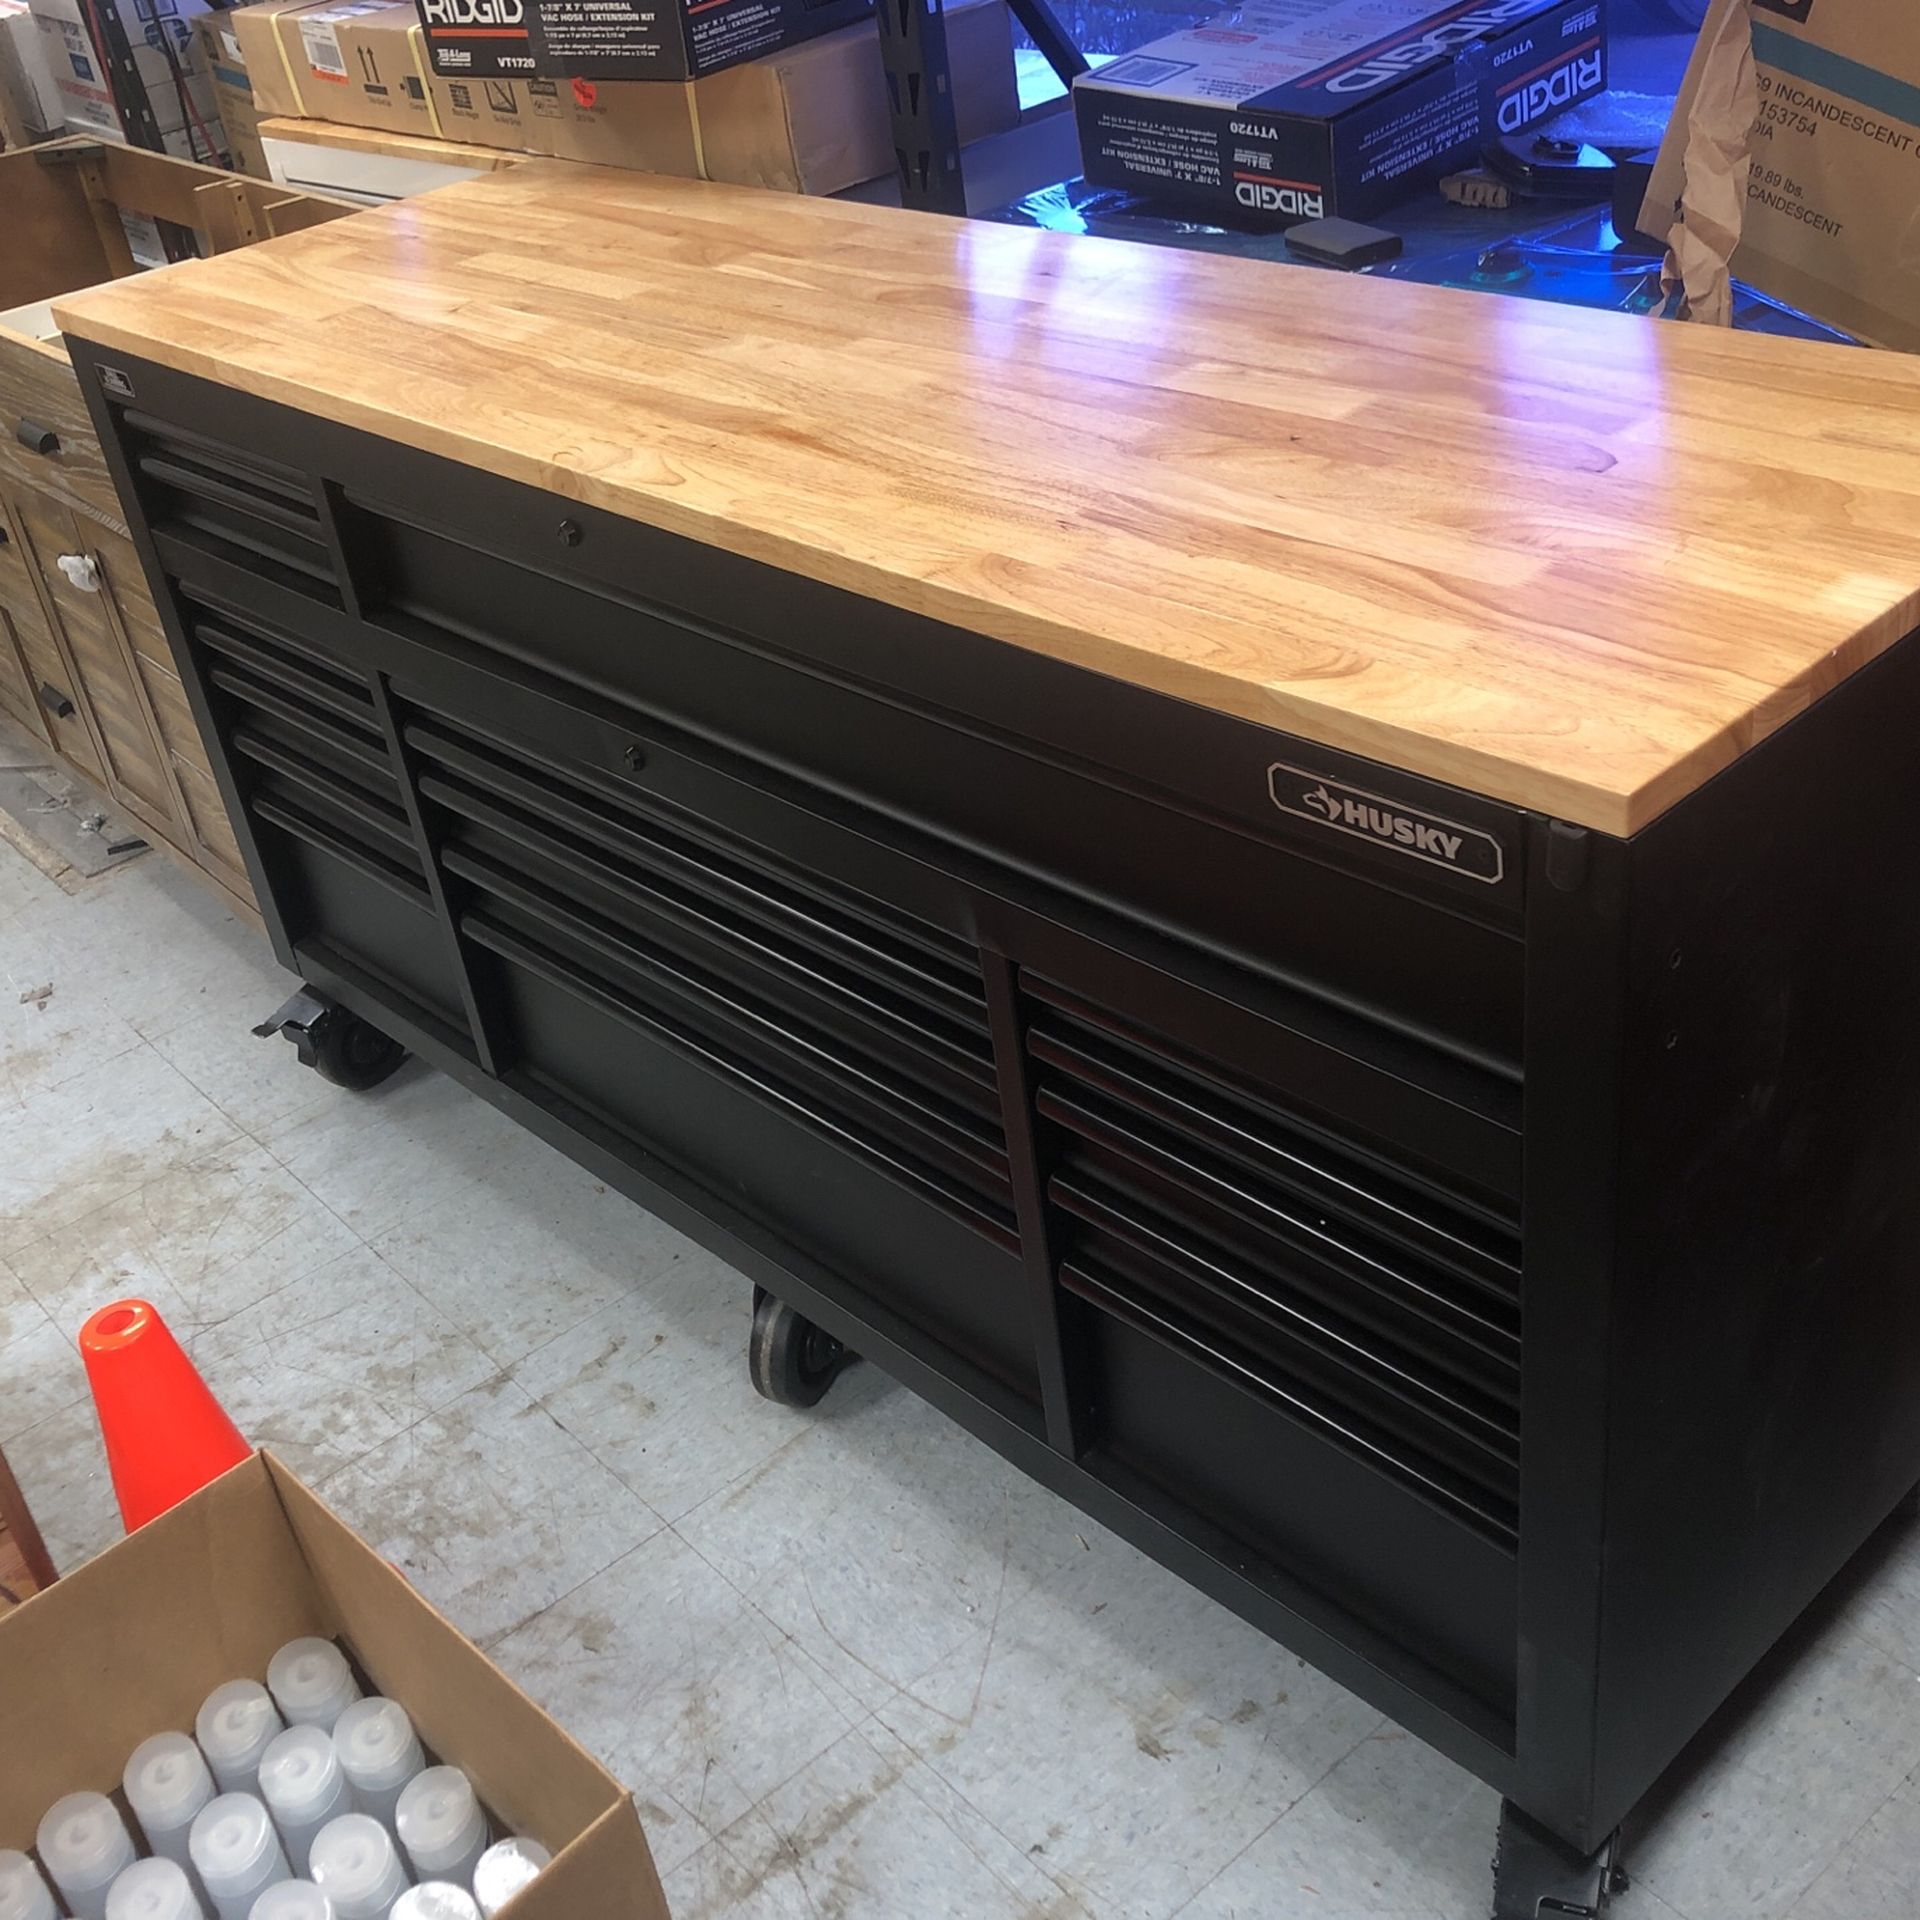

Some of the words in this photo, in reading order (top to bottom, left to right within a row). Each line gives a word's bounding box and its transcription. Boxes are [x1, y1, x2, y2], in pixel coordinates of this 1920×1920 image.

[422, 0, 523, 23] RIDGID
[583, 2, 632, 11] UNIVERSAL
[541, 13, 558, 21] VAC
[560, 13, 584, 21] HOSE
[590, 13, 639, 21] EXTENSION
[1325, 0, 1542, 93] RIDGID
[1493, 39, 1534, 67] VT1720
[497, 57, 537, 69] VT1720
[1497, 48, 1602, 133] RIDGID
[1460, 115, 1479, 129] VAC
[1759, 99, 1818, 136] 153754
[1774, 83, 1913, 151] INCANDESCENT
[1230, 121, 1279, 140] VT1720
[1434, 125, 1459, 144] HOSE
[1101, 147, 1116, 156] KIT
[1117, 150, 1166, 166] EXTENSION
[1376, 141, 1428, 174] EXTENSION
[1123, 160, 1173, 177] UNIVERSAL
[1173, 160, 1199, 172] HOSE
[1201, 165, 1221, 176] VAC
[1383, 149, 1435, 180] UNIVERSAL
[1184, 173, 1192, 181] X
[1360, 168, 1376, 183] KIT
[1783, 177, 1804, 199] lbs.
[1235, 181, 1324, 219] RIDGID
[1747, 182, 1844, 237] CANDESCENT
[1343, 798, 1463, 860] HUSKY
